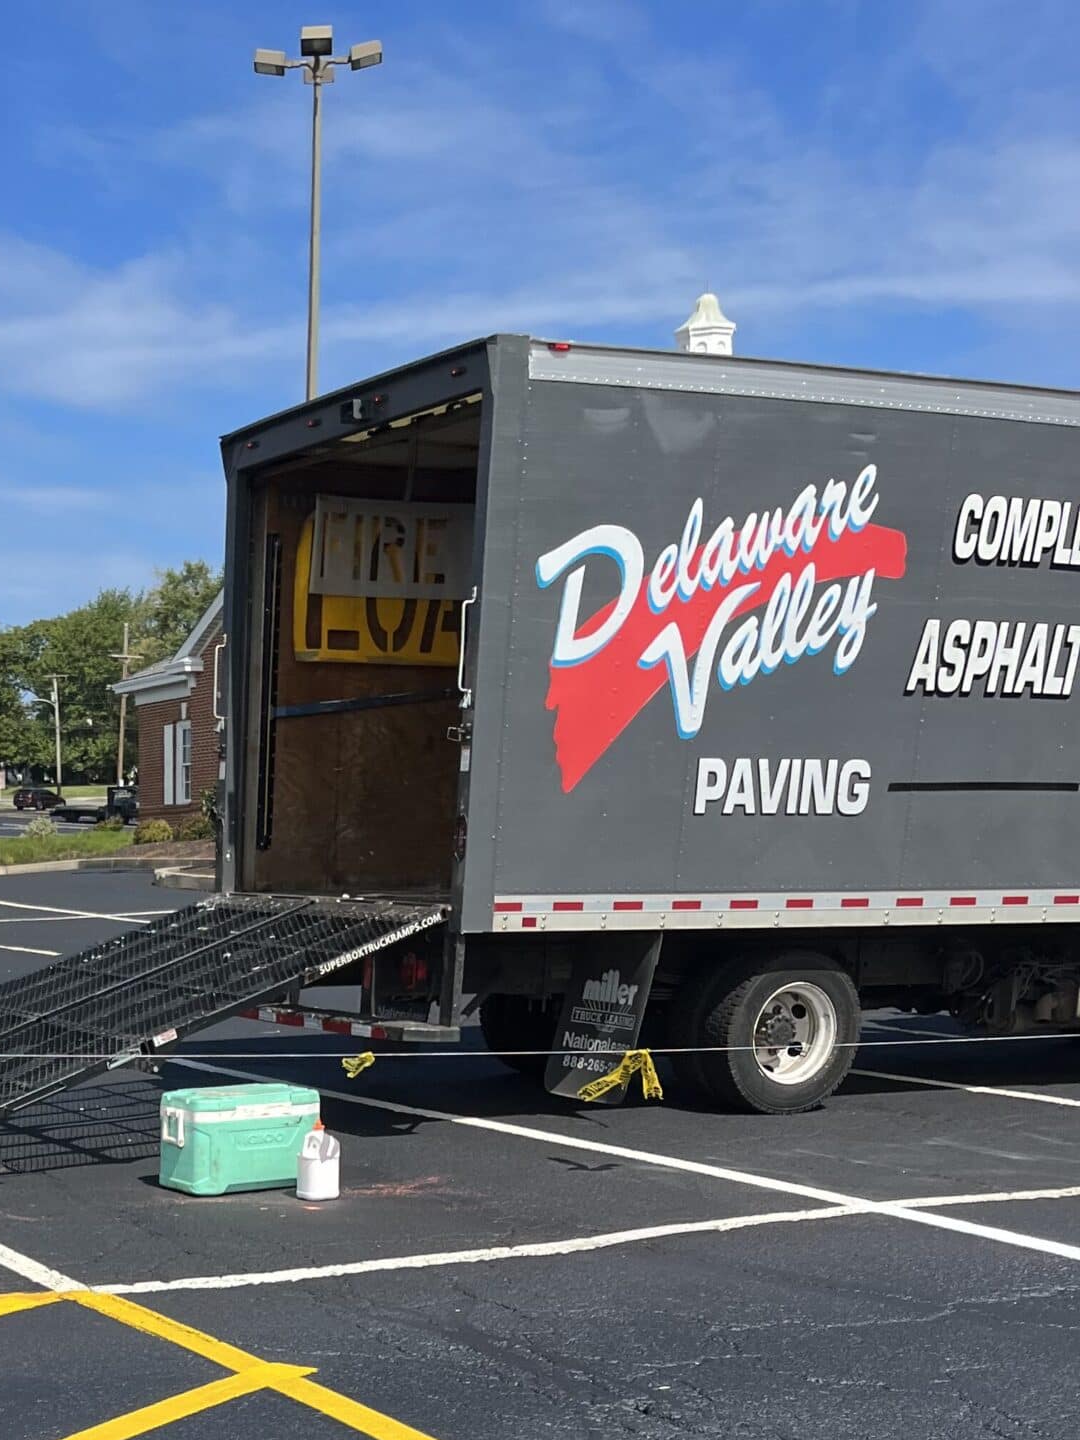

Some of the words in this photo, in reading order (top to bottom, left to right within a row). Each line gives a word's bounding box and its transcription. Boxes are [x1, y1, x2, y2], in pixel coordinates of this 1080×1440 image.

[320, 511, 449, 585] FIRE
[536, 464, 880, 669] Delaware
[637, 562, 878, 740] Valley
[904, 618, 1080, 699] ASPHALT
[694, 758, 872, 816] PAVING
[319, 912, 442, 976] SUPERBOXTRUCKRAMPS.COM
